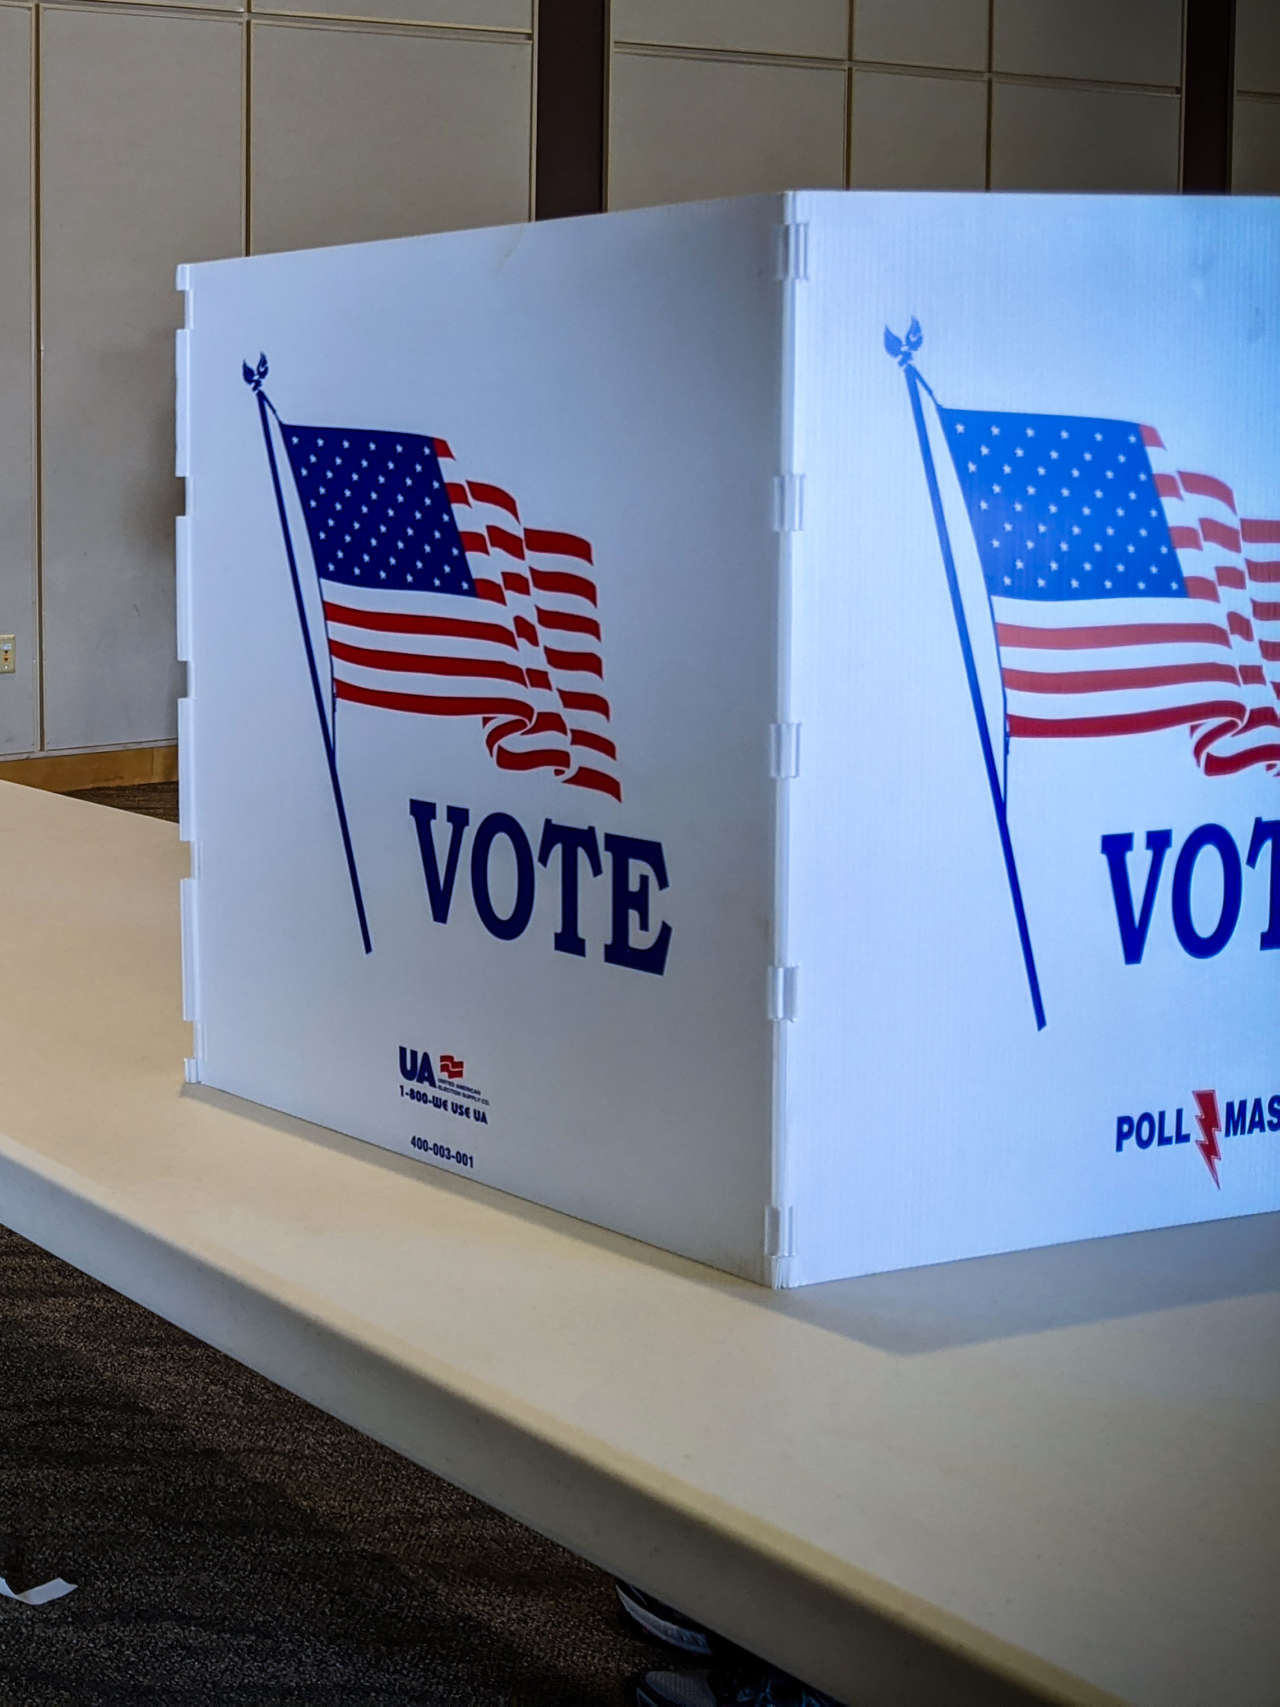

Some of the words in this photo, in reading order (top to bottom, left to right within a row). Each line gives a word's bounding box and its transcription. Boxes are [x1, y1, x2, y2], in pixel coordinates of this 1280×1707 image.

[409, 798, 673, 976] VOTE
[399, 1045, 437, 1088] UA
[400, 1085, 449, 1112] 1-800-WE
[451, 1101, 471, 1119] USE
[473, 1108, 488, 1125] UA
[1115, 1107, 1191, 1153] POLL
[1224, 1094, 1280, 1138] MAS
[410, 1135, 474, 1168] 400-003-001
